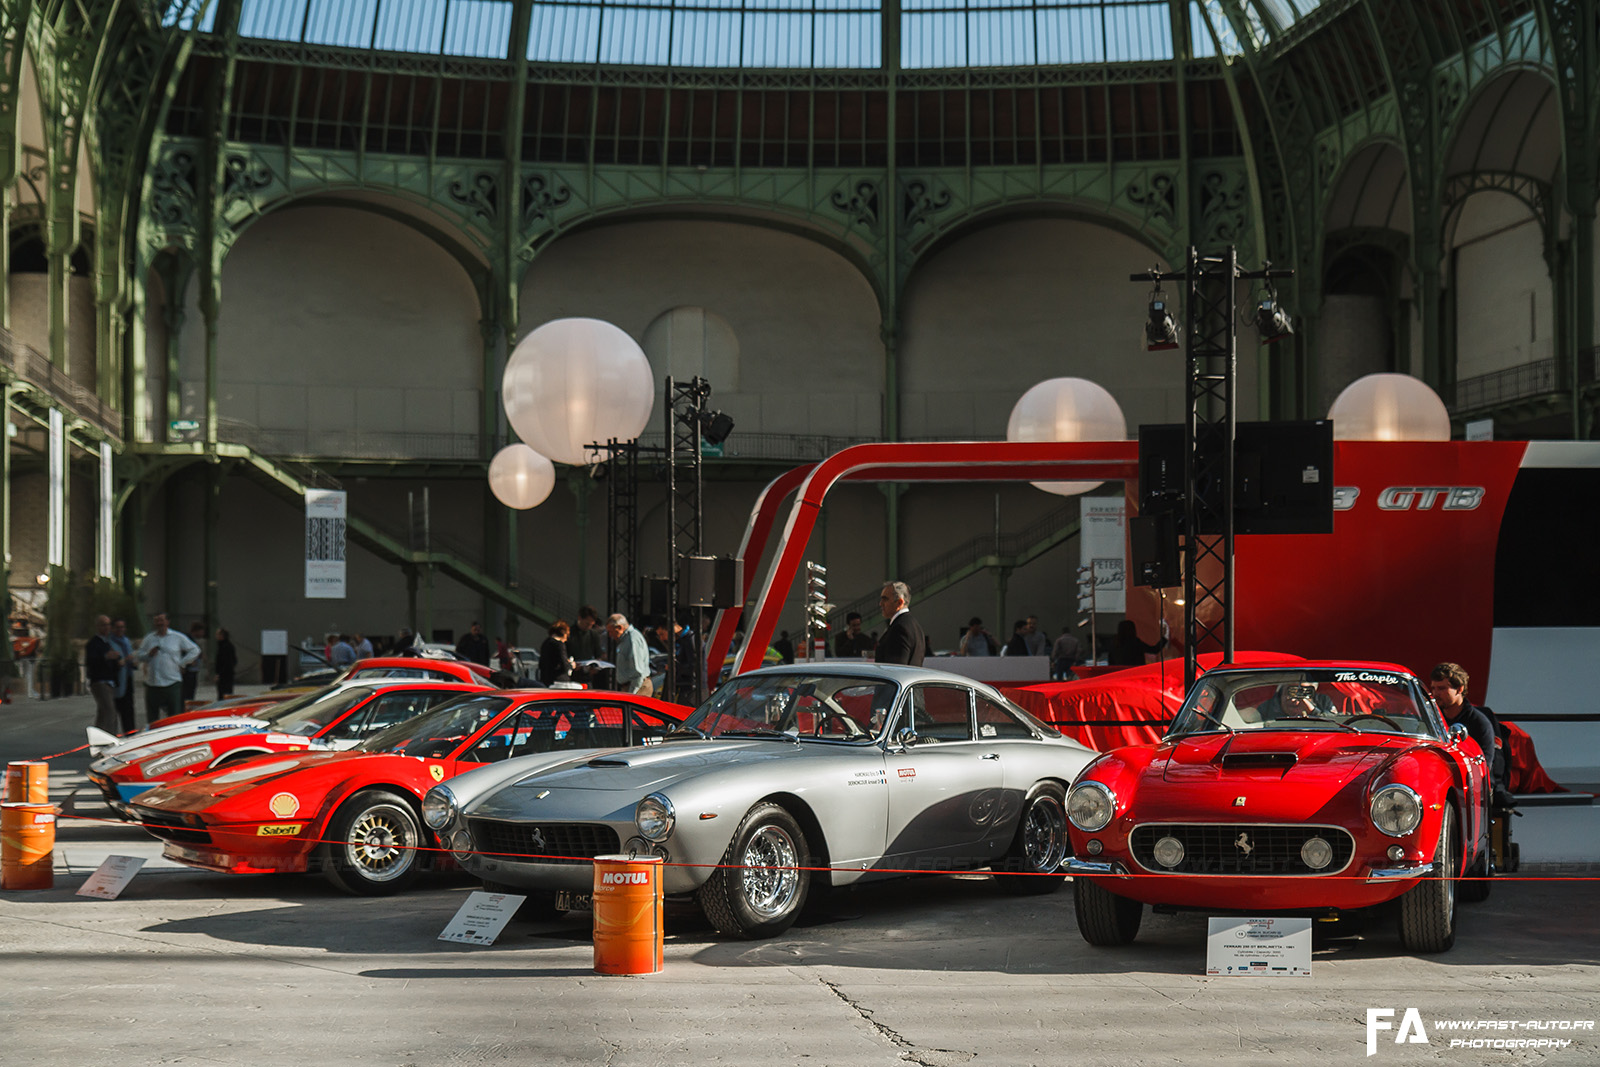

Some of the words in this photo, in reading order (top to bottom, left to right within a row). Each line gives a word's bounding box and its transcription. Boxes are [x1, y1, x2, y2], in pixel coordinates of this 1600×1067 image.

[1377, 486, 1486, 511] GTB
[1334, 672, 1358, 682] The
[602, 872, 649, 885] MOTUL
